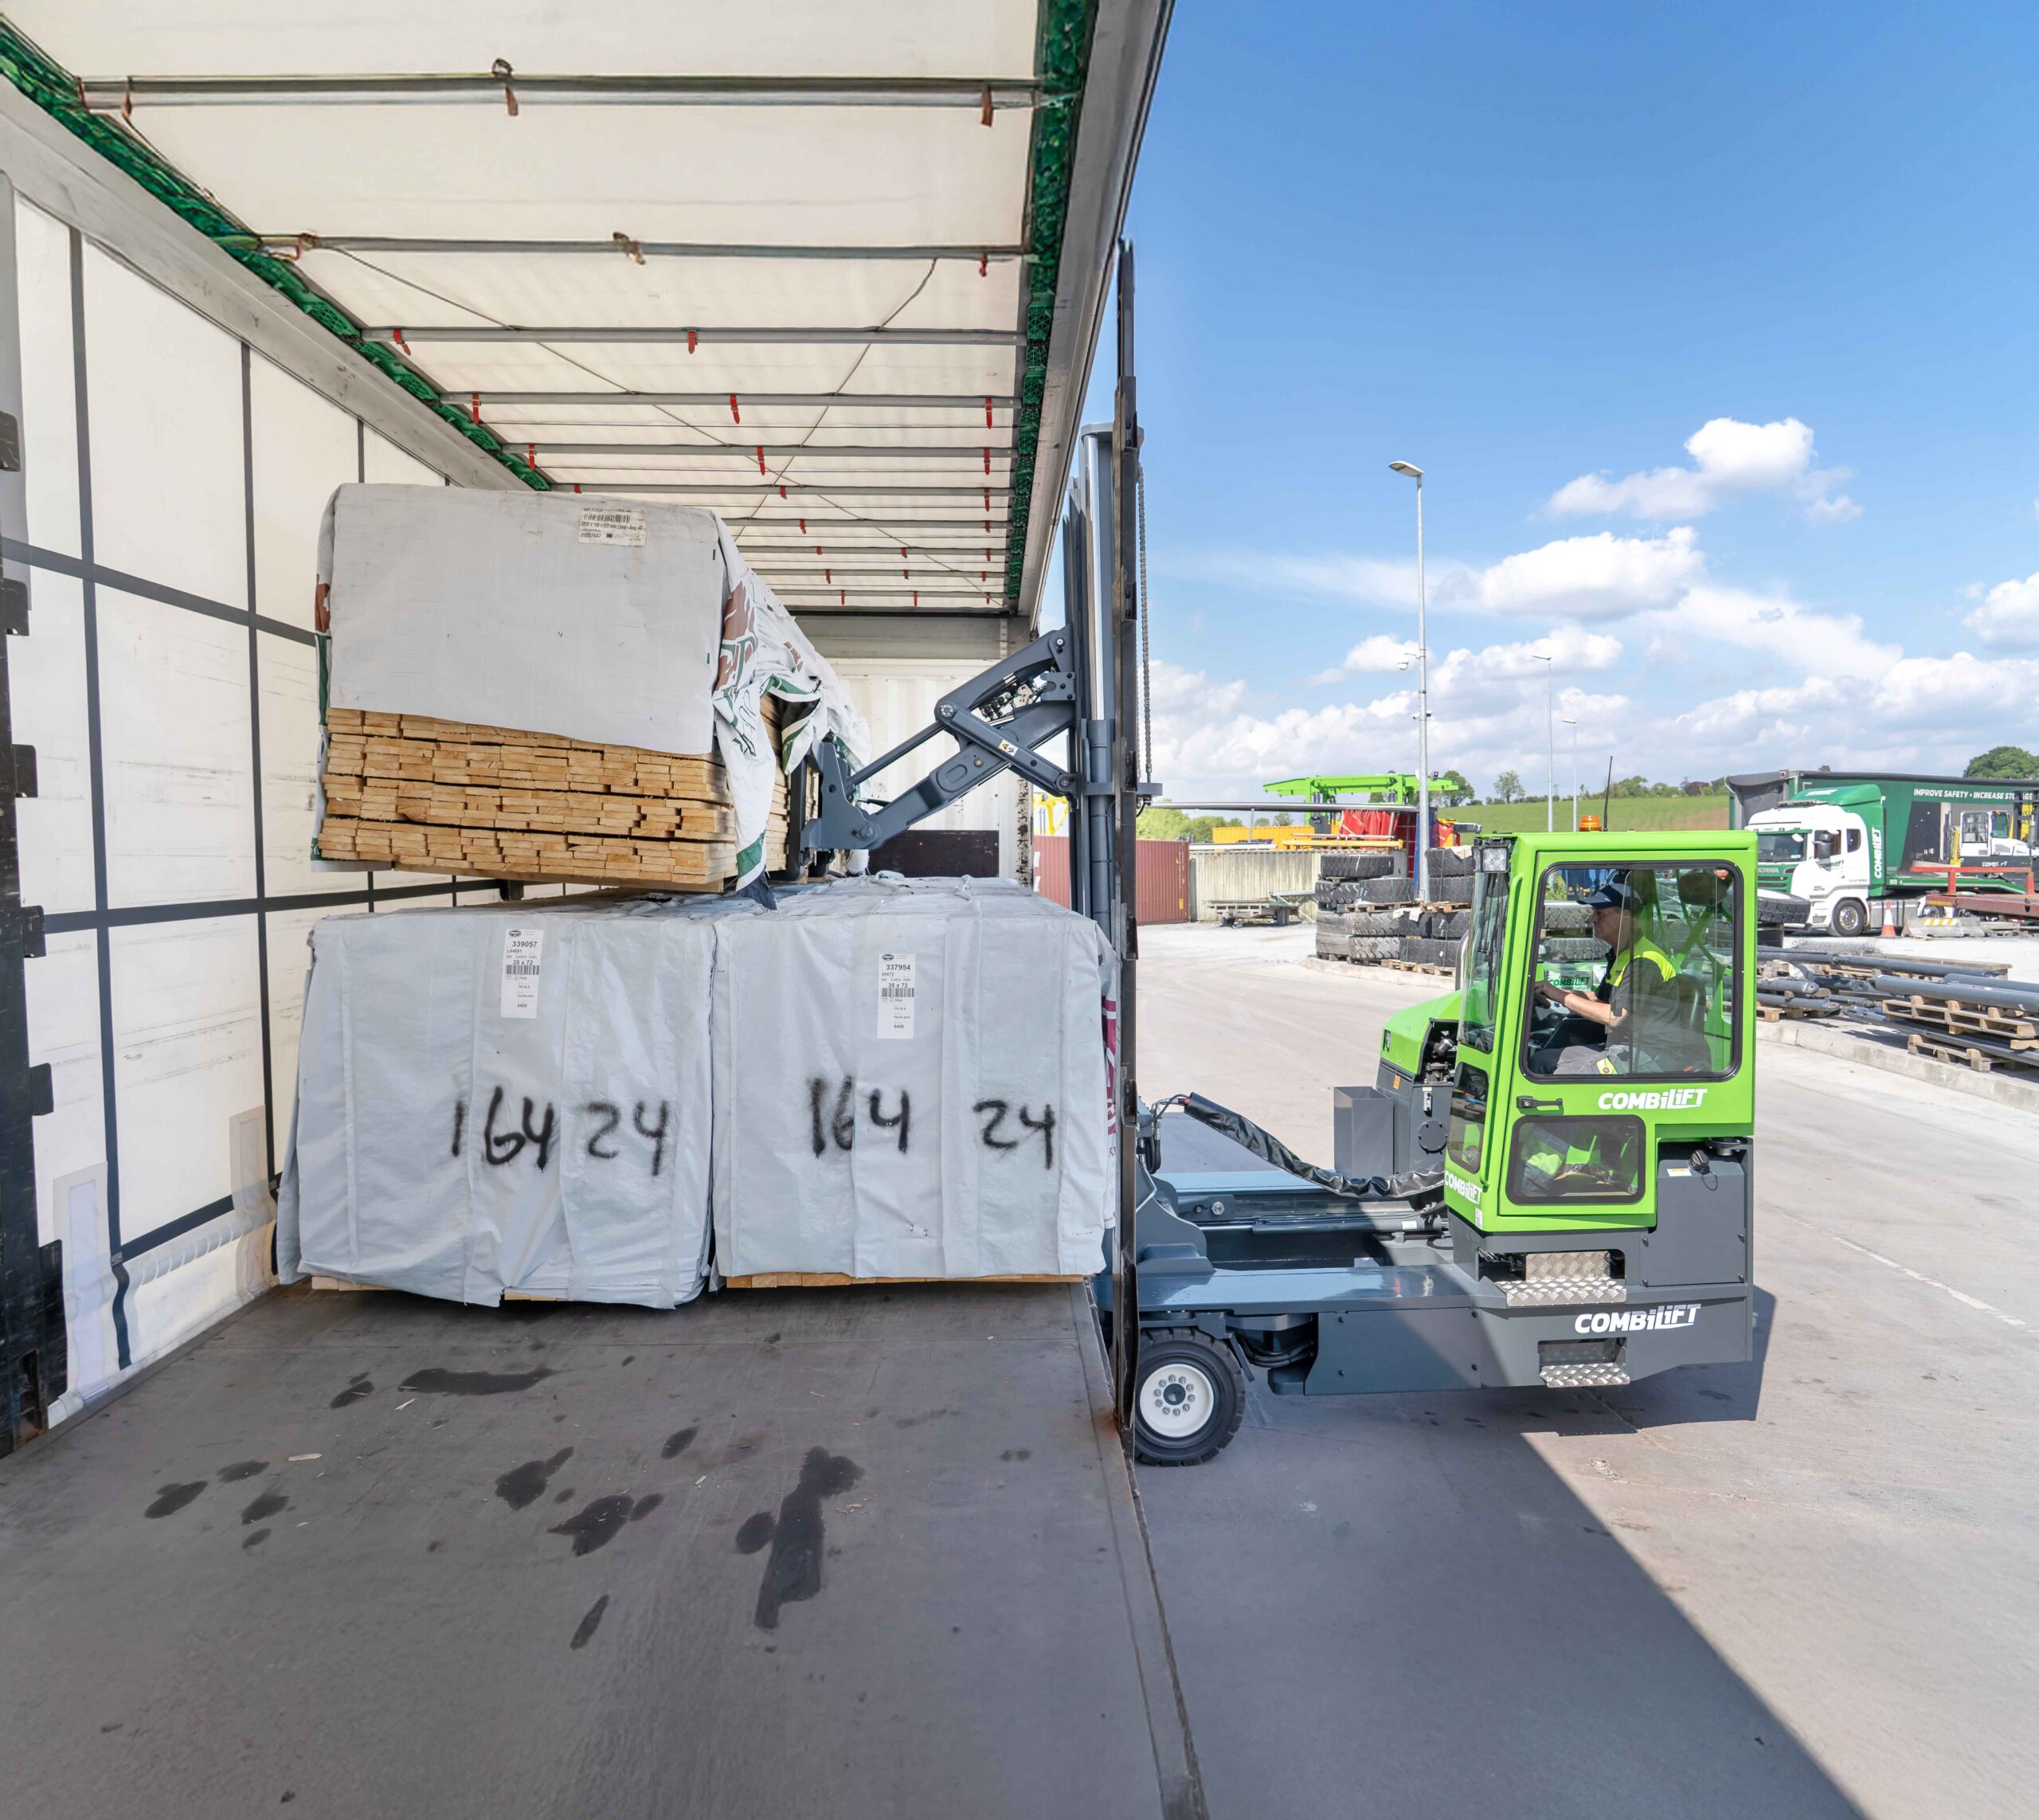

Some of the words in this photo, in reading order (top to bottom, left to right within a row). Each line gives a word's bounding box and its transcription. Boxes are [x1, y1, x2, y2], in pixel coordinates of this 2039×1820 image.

[1913, 789, 1943, 797] IMPROVE
[1943, 789, 1969, 798] SAFETY
[1973, 791, 2003, 800] INCREASE
[452, 1086, 555, 1173] 164
[584, 1099, 669, 1176] 24
[809, 1075, 910, 1157] 164
[973, 1098, 1055, 1169] 24
